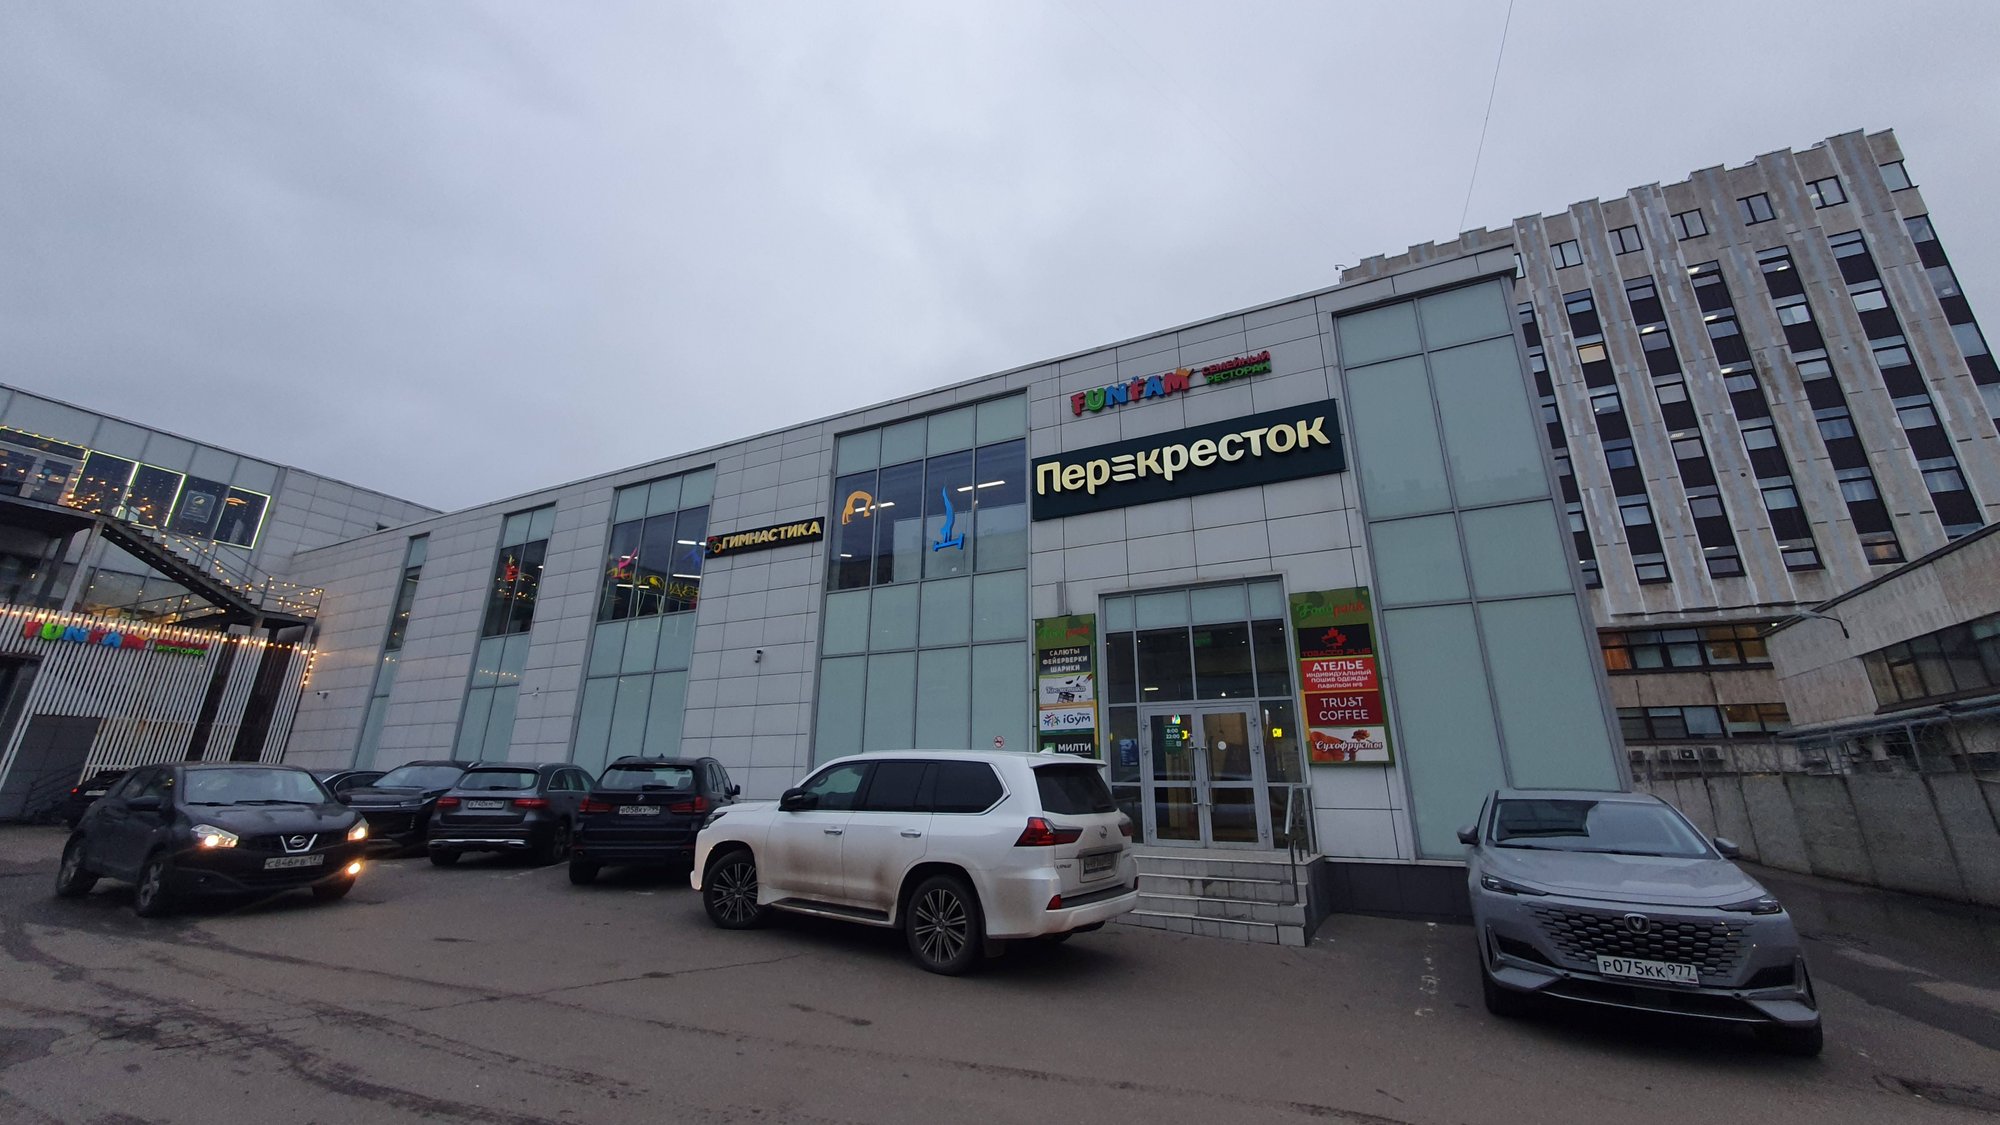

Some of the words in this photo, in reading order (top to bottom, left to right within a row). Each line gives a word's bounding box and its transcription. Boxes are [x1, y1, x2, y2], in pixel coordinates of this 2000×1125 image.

[1206, 361, 1271, 384] РЕСТОРАН
[1070, 369, 1192, 416] FUNFAM
[722, 521, 822, 549] ГИМНАСТИКА
[1049, 648, 1080, 656] САЛЮТЫ
[1050, 665, 1080, 673] ШАРИКИ
[1312, 660, 1364, 672] АТЕЛЬЕ
[1319, 709, 1369, 720] COFFEE
[1057, 743, 1091, 752] МИЛТИ
[1315, 741, 1383, 752] Сухофрукты
